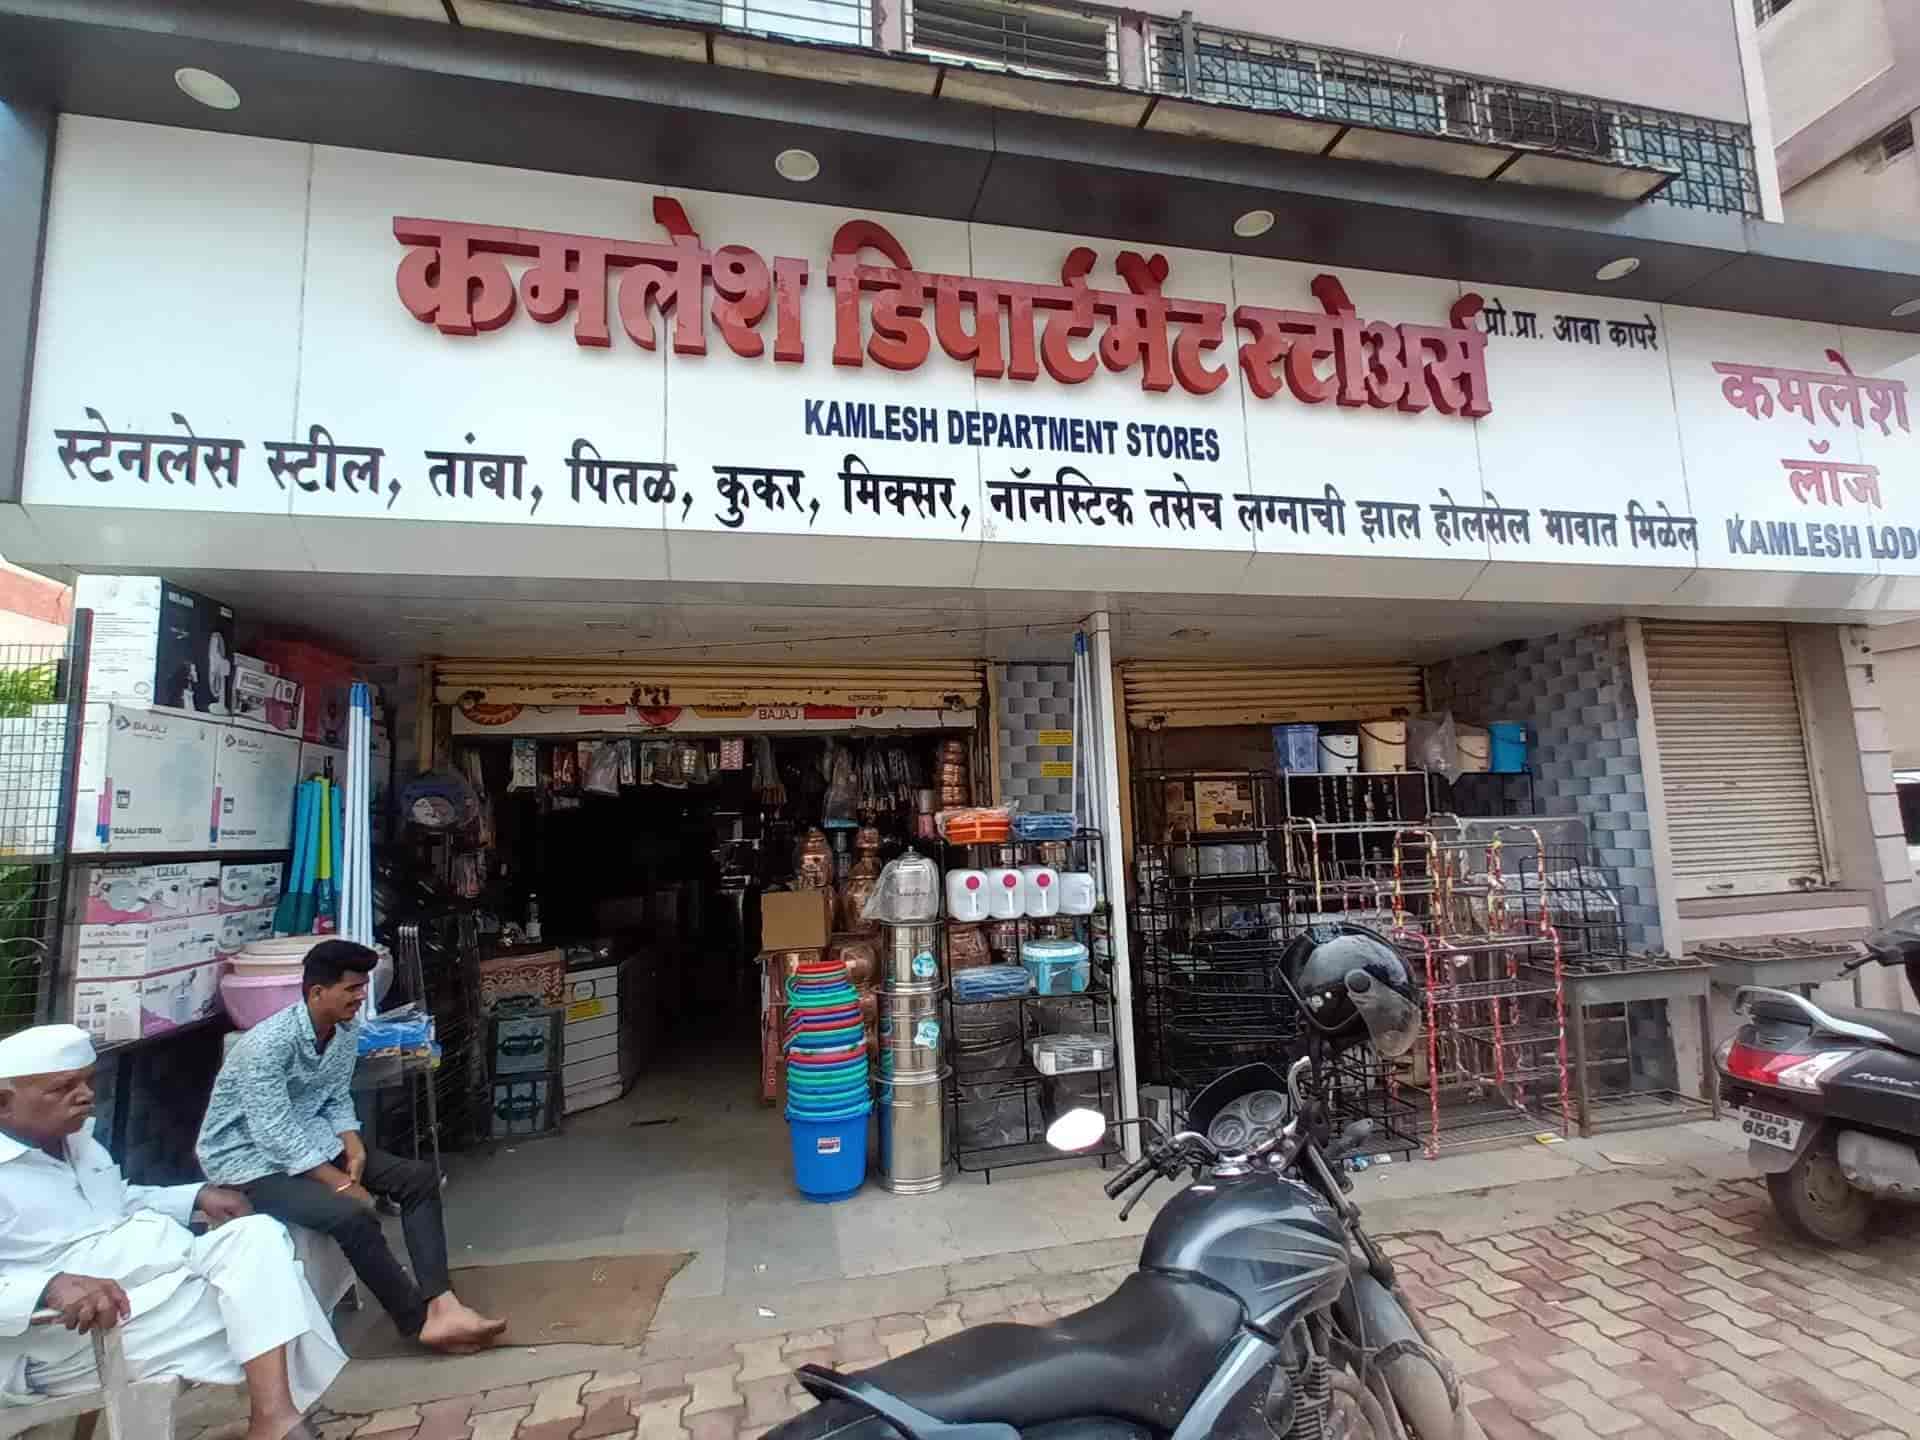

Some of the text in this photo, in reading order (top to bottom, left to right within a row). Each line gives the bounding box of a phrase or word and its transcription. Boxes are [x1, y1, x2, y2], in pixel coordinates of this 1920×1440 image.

[393, 196, 1492, 418] कमलेश डिपार्टमेंट स्टोअर्स
[1552, 314, 1601, 345] आबा
[1606, 314, 1659, 352] कापरे
[1711, 347, 1911, 437] कमलेश
[804, 399, 1220, 462] KAMLESH DEPARTMENT STORES
[55, 407, 1699, 551] स्टेनलेस स्टील, तांबा, पितळ, कुकर, मिक्सर, नॉनस्टिक तसेच लग्नाची झाल होलसेल भावात मिळेल
[1781, 438, 1883, 510] लॉज
[1725, 515, 1920, 560] KAMLESH LOD
[758, 708, 800, 720] BAJAJ
